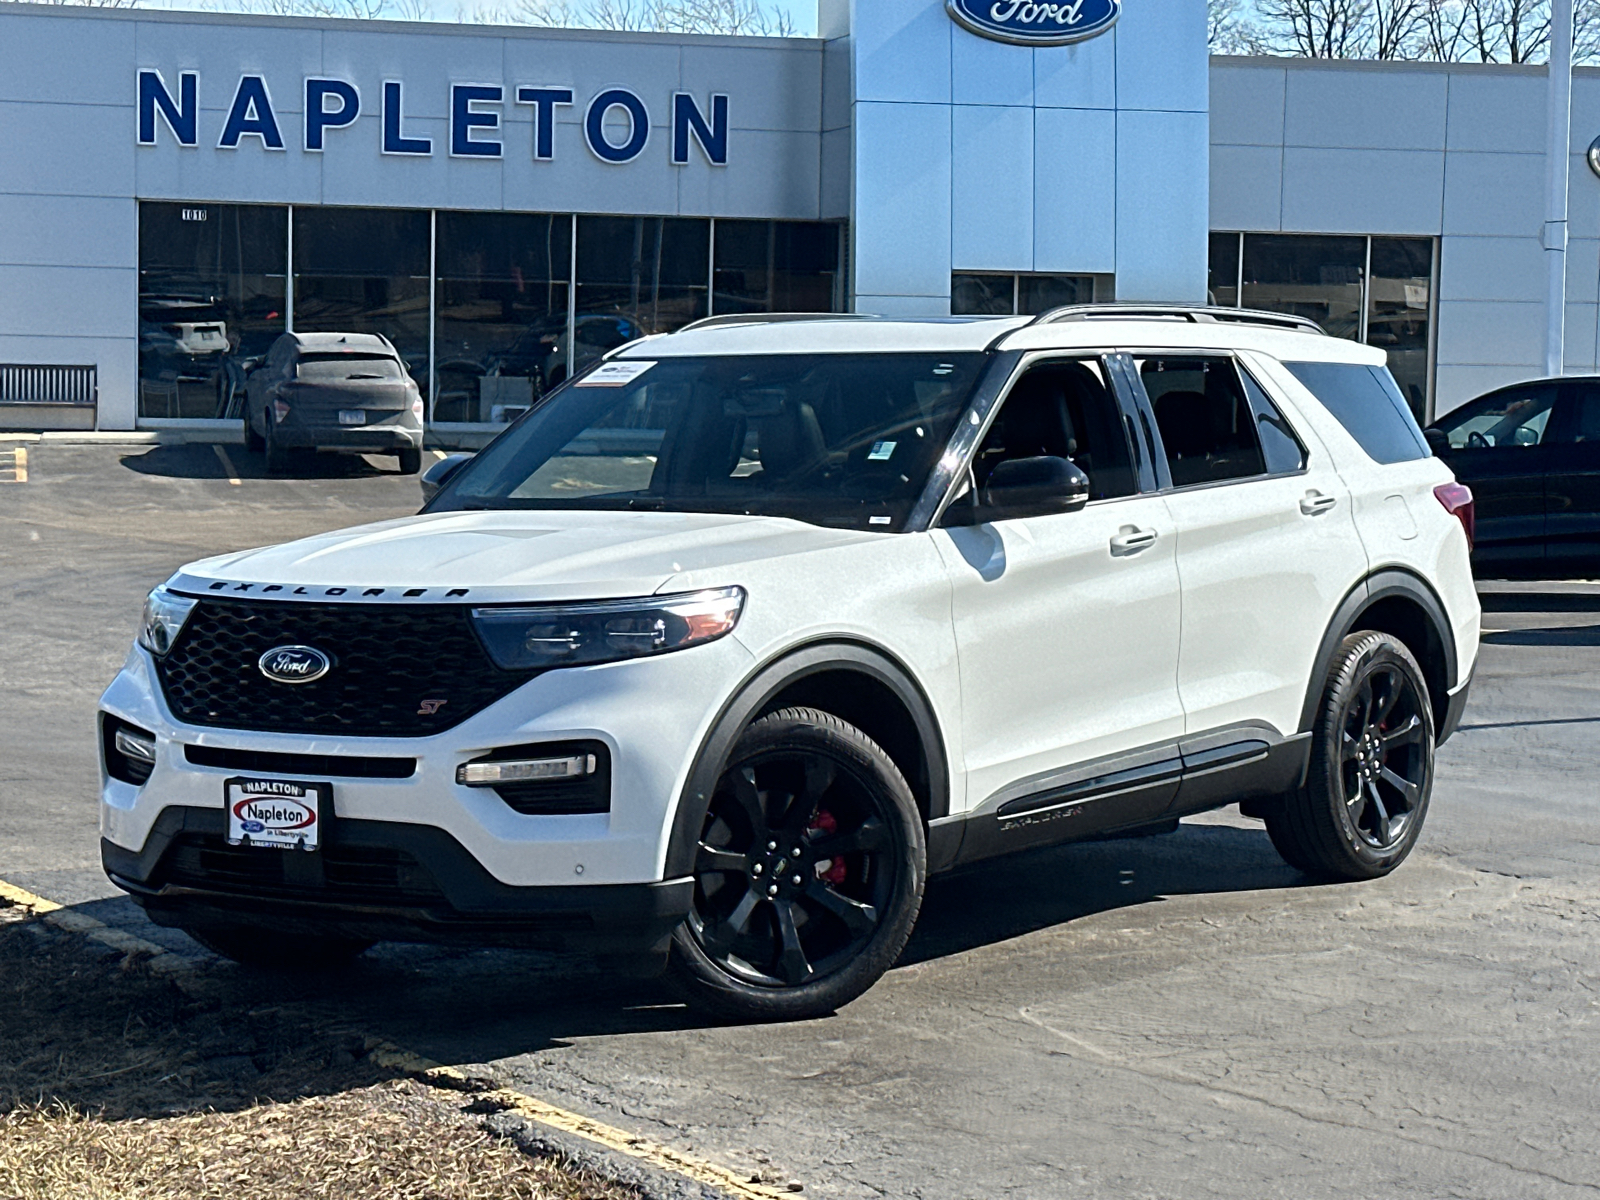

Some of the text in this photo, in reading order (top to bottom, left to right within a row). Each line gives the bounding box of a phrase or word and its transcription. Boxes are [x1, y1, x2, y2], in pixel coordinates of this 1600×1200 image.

[990, 0, 1083, 25] Ford
[137, 68, 730, 166] NAPLETON
[184, 210, 206, 220] 1010
[208, 581, 470, 597] EXPLORER
[272, 651, 311, 674] Ford
[417, 699, 448, 715] ST
[247, 782, 299, 795] NAPLETON
[247, 804, 302, 823] Napleton
